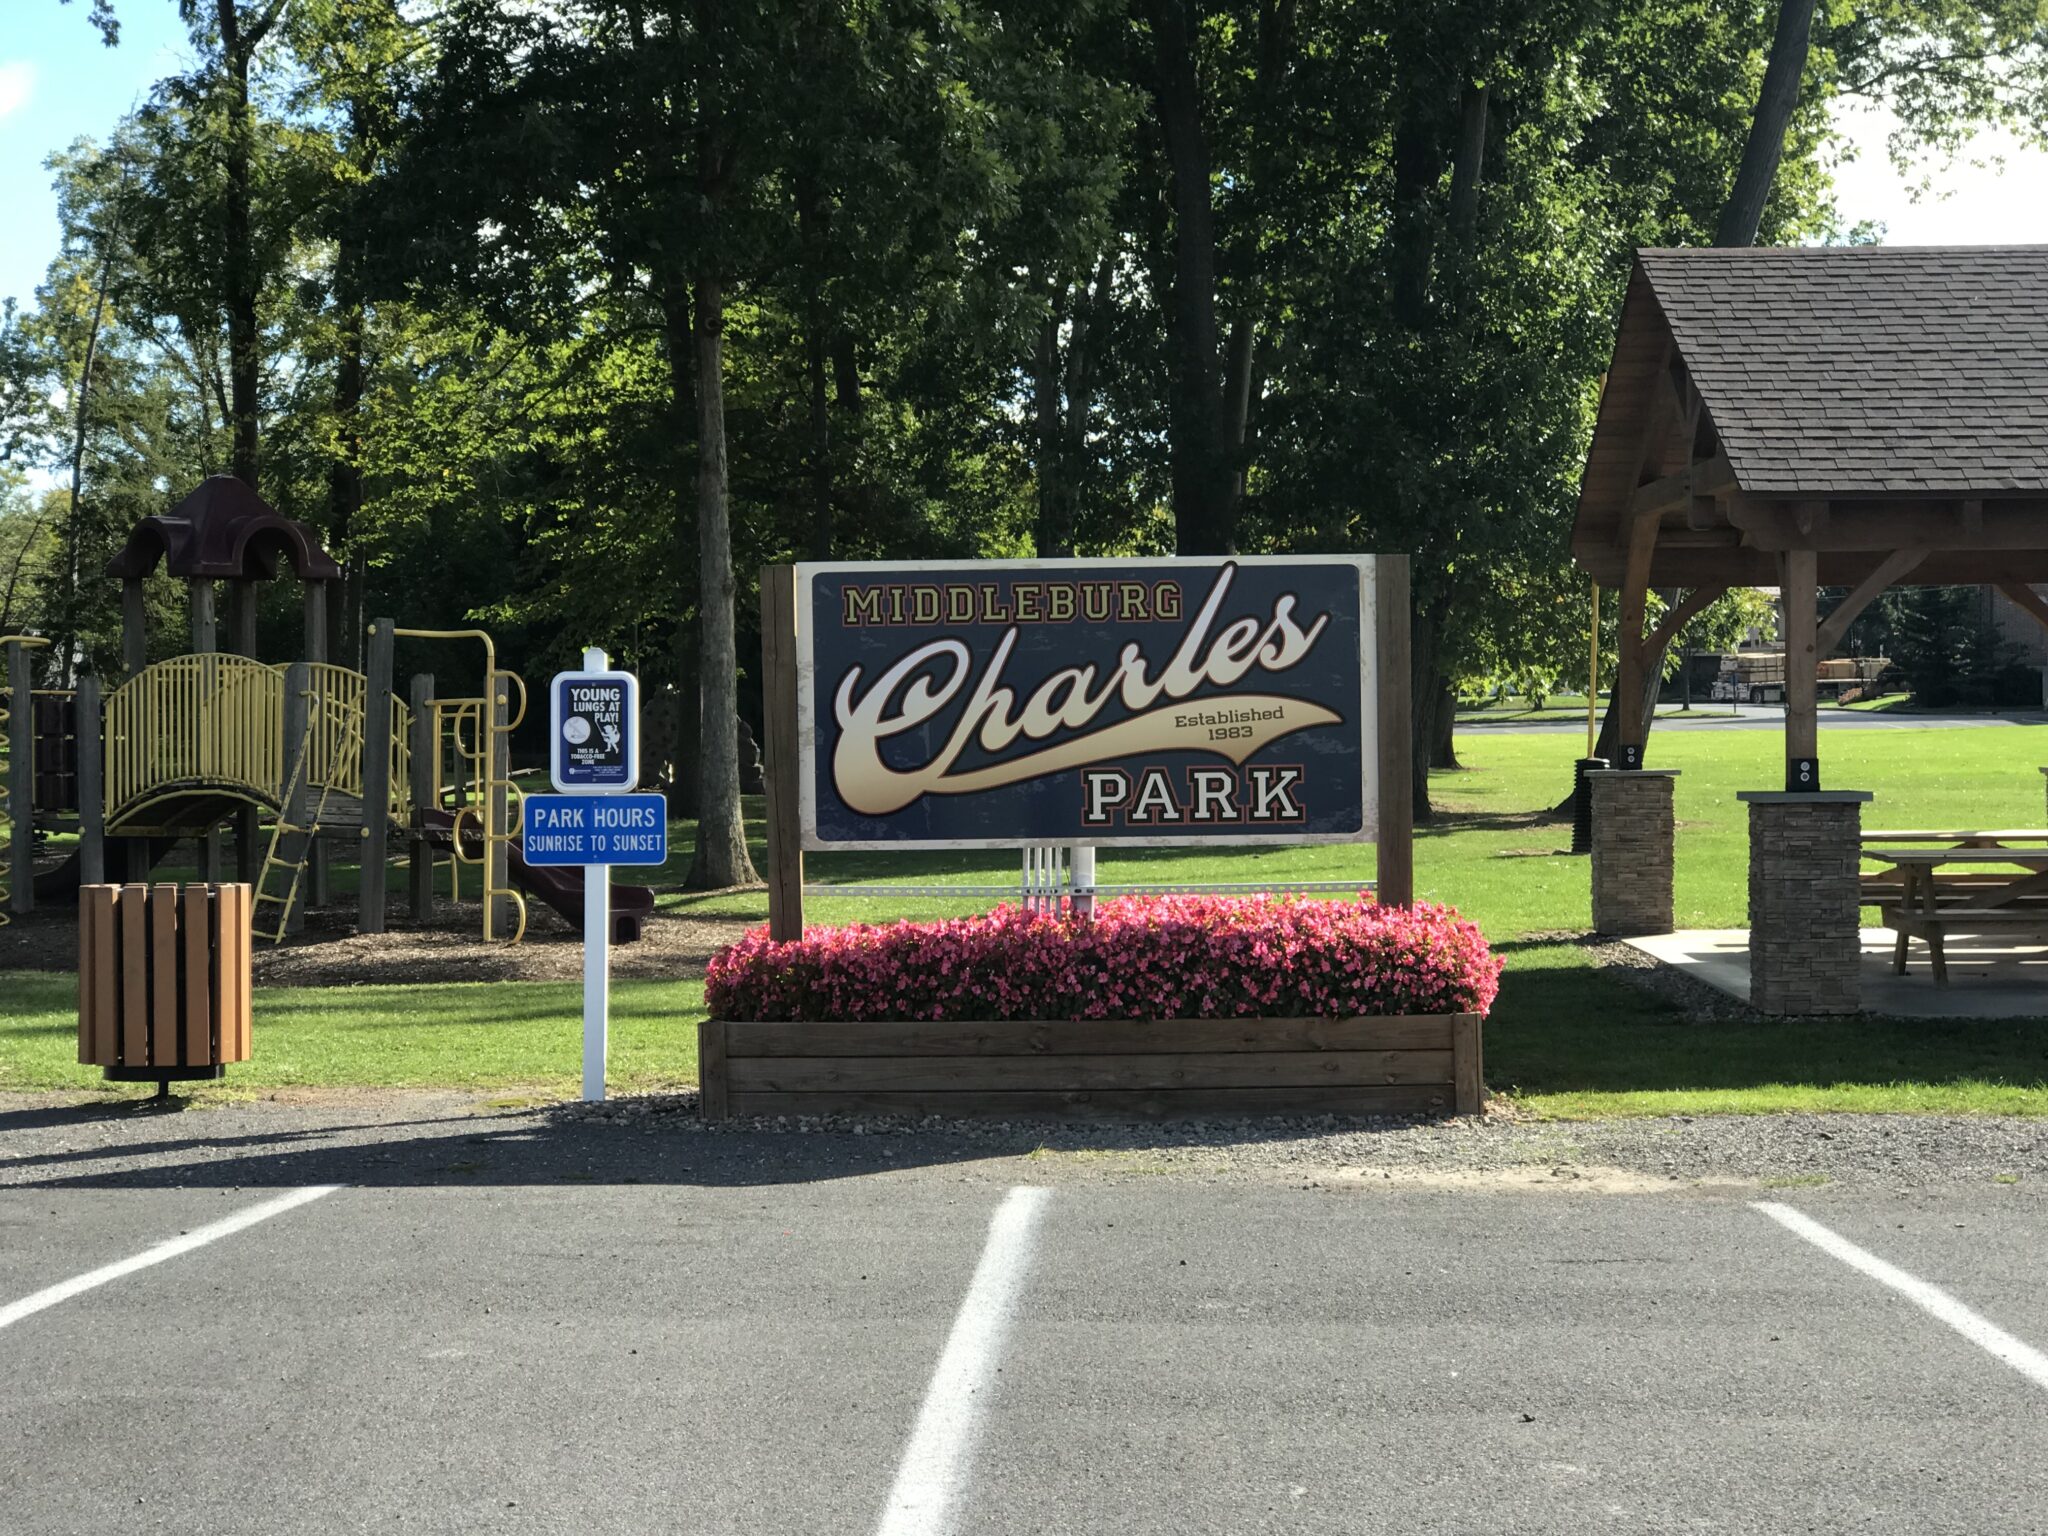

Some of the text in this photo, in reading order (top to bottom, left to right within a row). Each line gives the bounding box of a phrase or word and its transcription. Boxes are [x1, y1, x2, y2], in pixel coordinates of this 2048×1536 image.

[842, 581, 1182, 626] MIDDLEBURG
[571, 688, 620, 701] YOUNG
[834, 563, 1330, 814] Charles
[573, 702, 620, 712] LUNGS AT
[594, 713, 619, 723] PLAY!
[1175, 706, 1285, 728] Established
[1208, 728, 1254, 740] 1983
[1081, 765, 1306, 827] PARK
[534, 808, 656, 828] PARK HOURS
[528, 835, 662, 851] SUNRISE TO SUNSET
